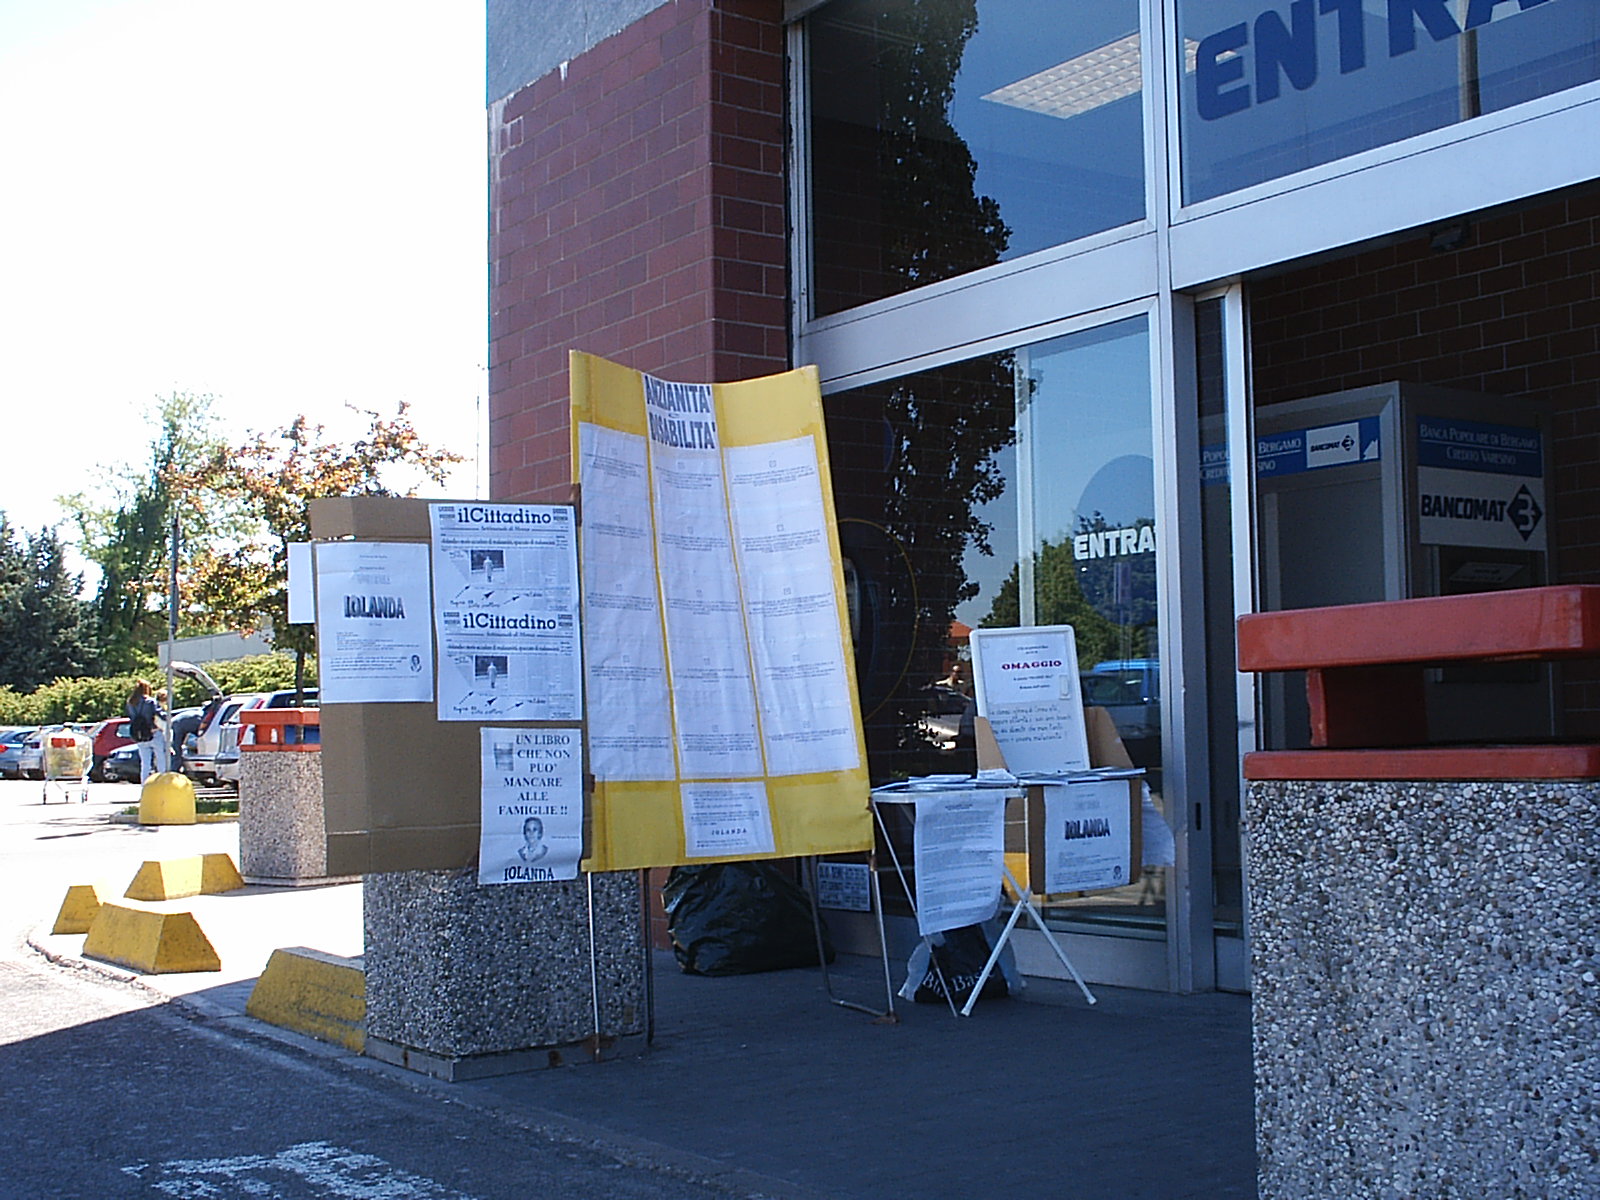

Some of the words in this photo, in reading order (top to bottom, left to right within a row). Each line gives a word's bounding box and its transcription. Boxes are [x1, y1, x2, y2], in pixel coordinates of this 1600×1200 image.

[1421, 494, 1507, 522] BANCOMAT
[343, 595, 406, 619] IOLANDA
[1001, 660, 1062, 671] OMAGGIO
[515, 734, 533, 745] UN
[535, 734, 570, 745] LIBRO
[517, 749, 543, 759] CHE
[545, 749, 571, 759] NON
[503, 777, 562, 788] MANCARE
[517, 791, 549, 801] ALLE
[498, 806, 557, 816] FAMIGLIE
[1064, 817, 1111, 840] IOLANDA
[504, 865, 555, 882] IOLANDA
